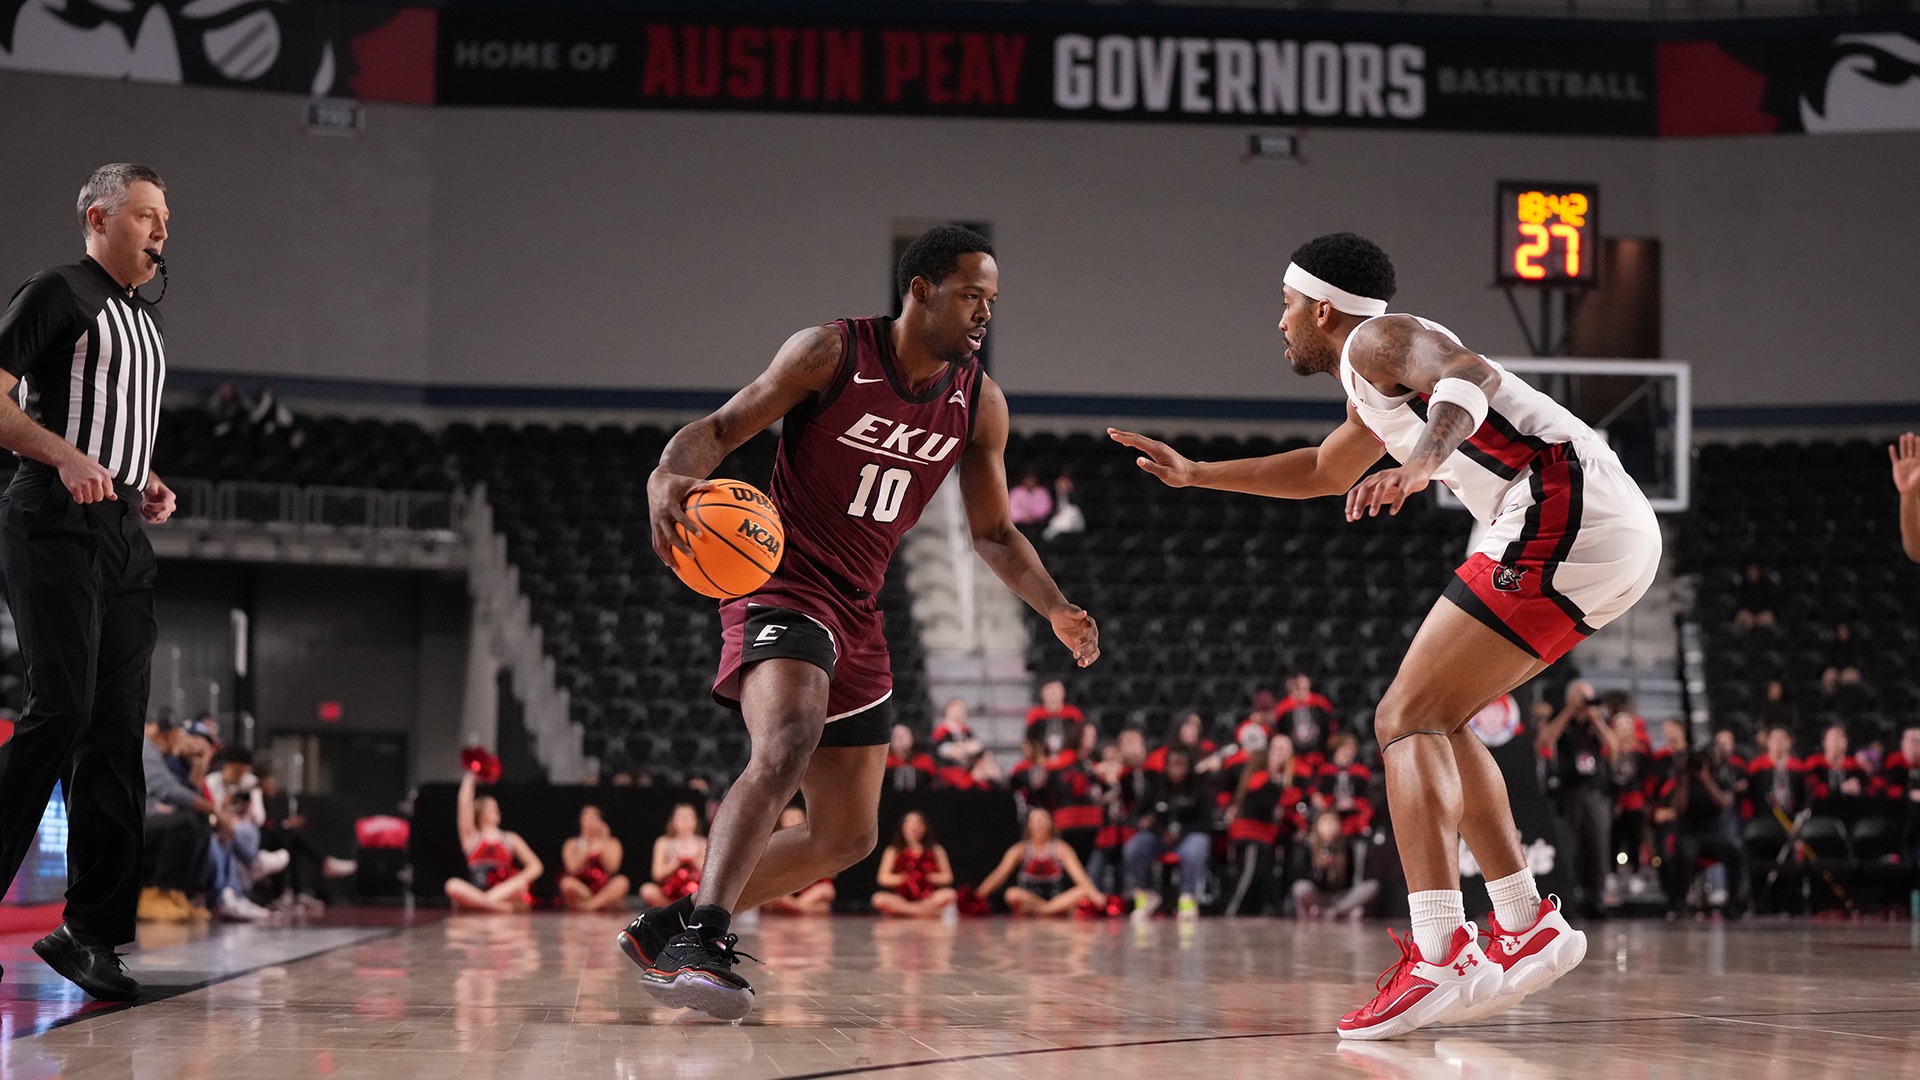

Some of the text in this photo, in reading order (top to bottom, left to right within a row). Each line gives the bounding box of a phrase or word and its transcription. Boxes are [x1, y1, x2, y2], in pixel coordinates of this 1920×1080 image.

[454, 24, 1645, 119] HOME OF AUSTIN PEAY GOVERNORS BASKETBALL
[1514, 222, 1580, 279] 27
[844, 412, 960, 462] EKU
[846, 463, 913, 523] 10
[737, 518, 780, 558] NCAA
